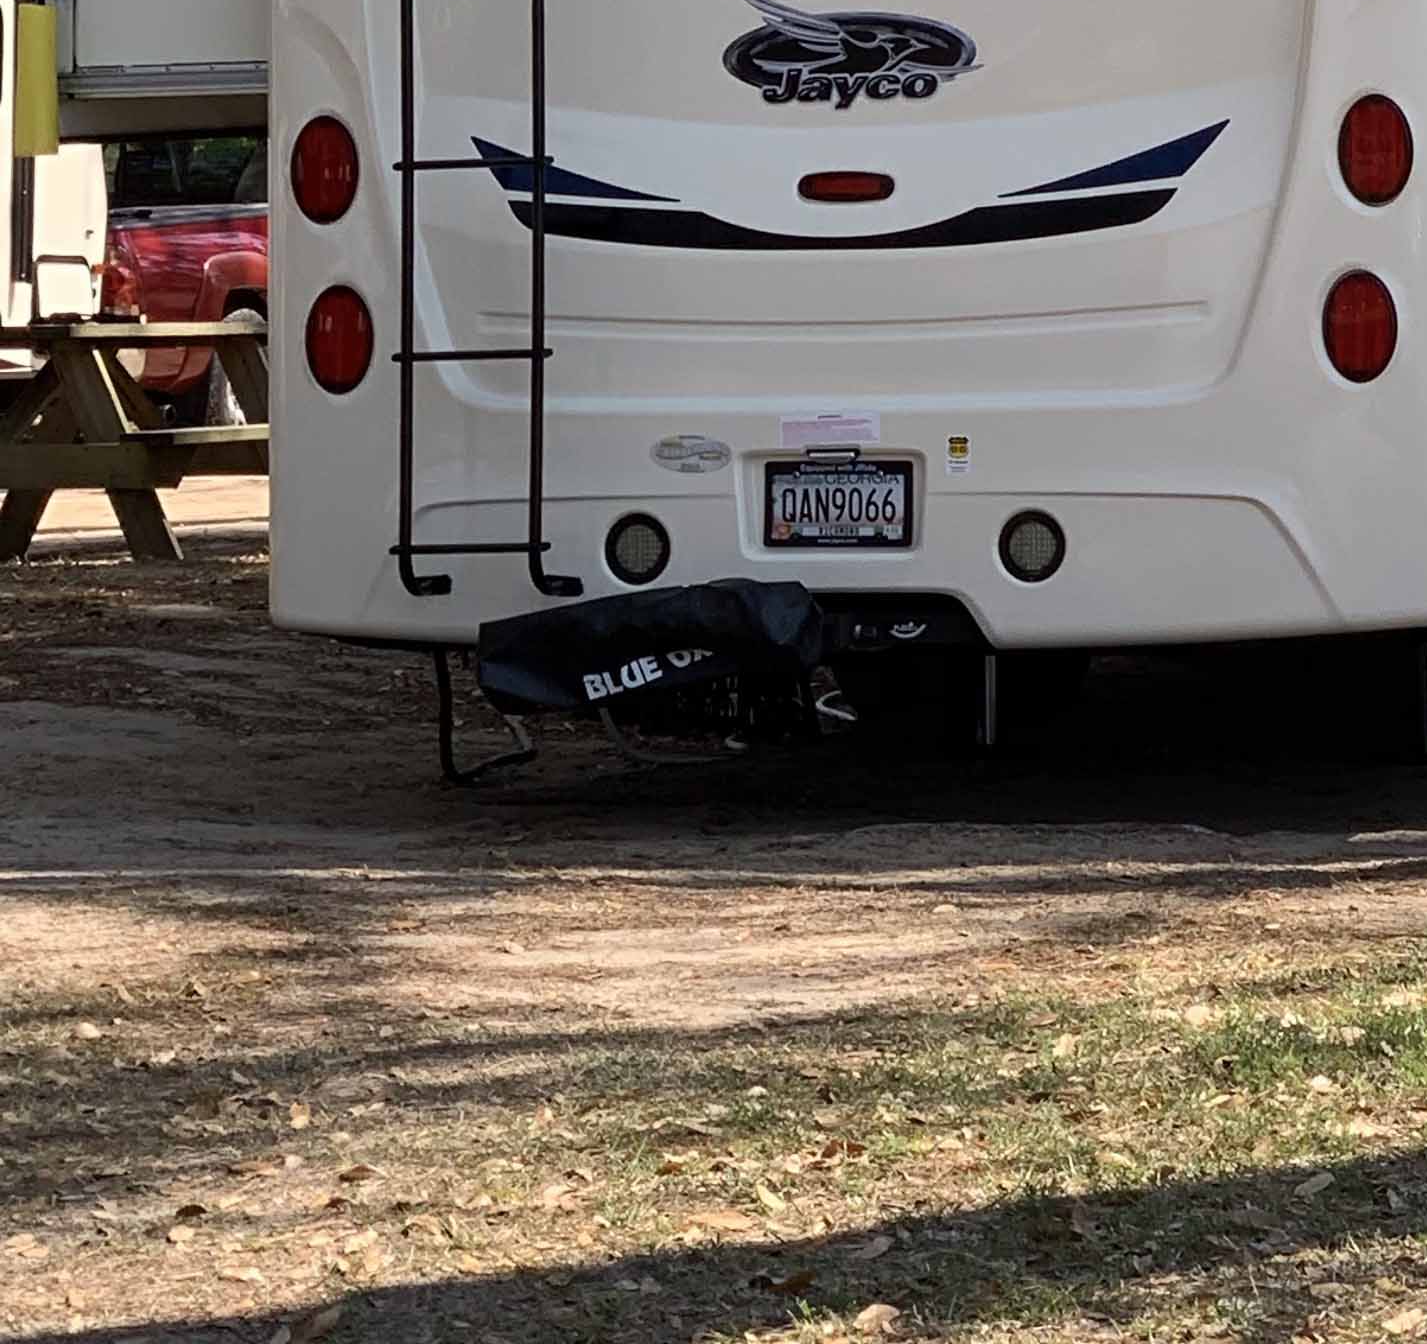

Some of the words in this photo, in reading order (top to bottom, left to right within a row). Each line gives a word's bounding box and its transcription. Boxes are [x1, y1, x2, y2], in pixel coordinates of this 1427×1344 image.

[761, 66, 940, 110] Jayco
[824, 474, 900, 486] GEORGIA
[782, 488, 896, 523] QAN9066
[583, 655, 663, 701] BLUE
